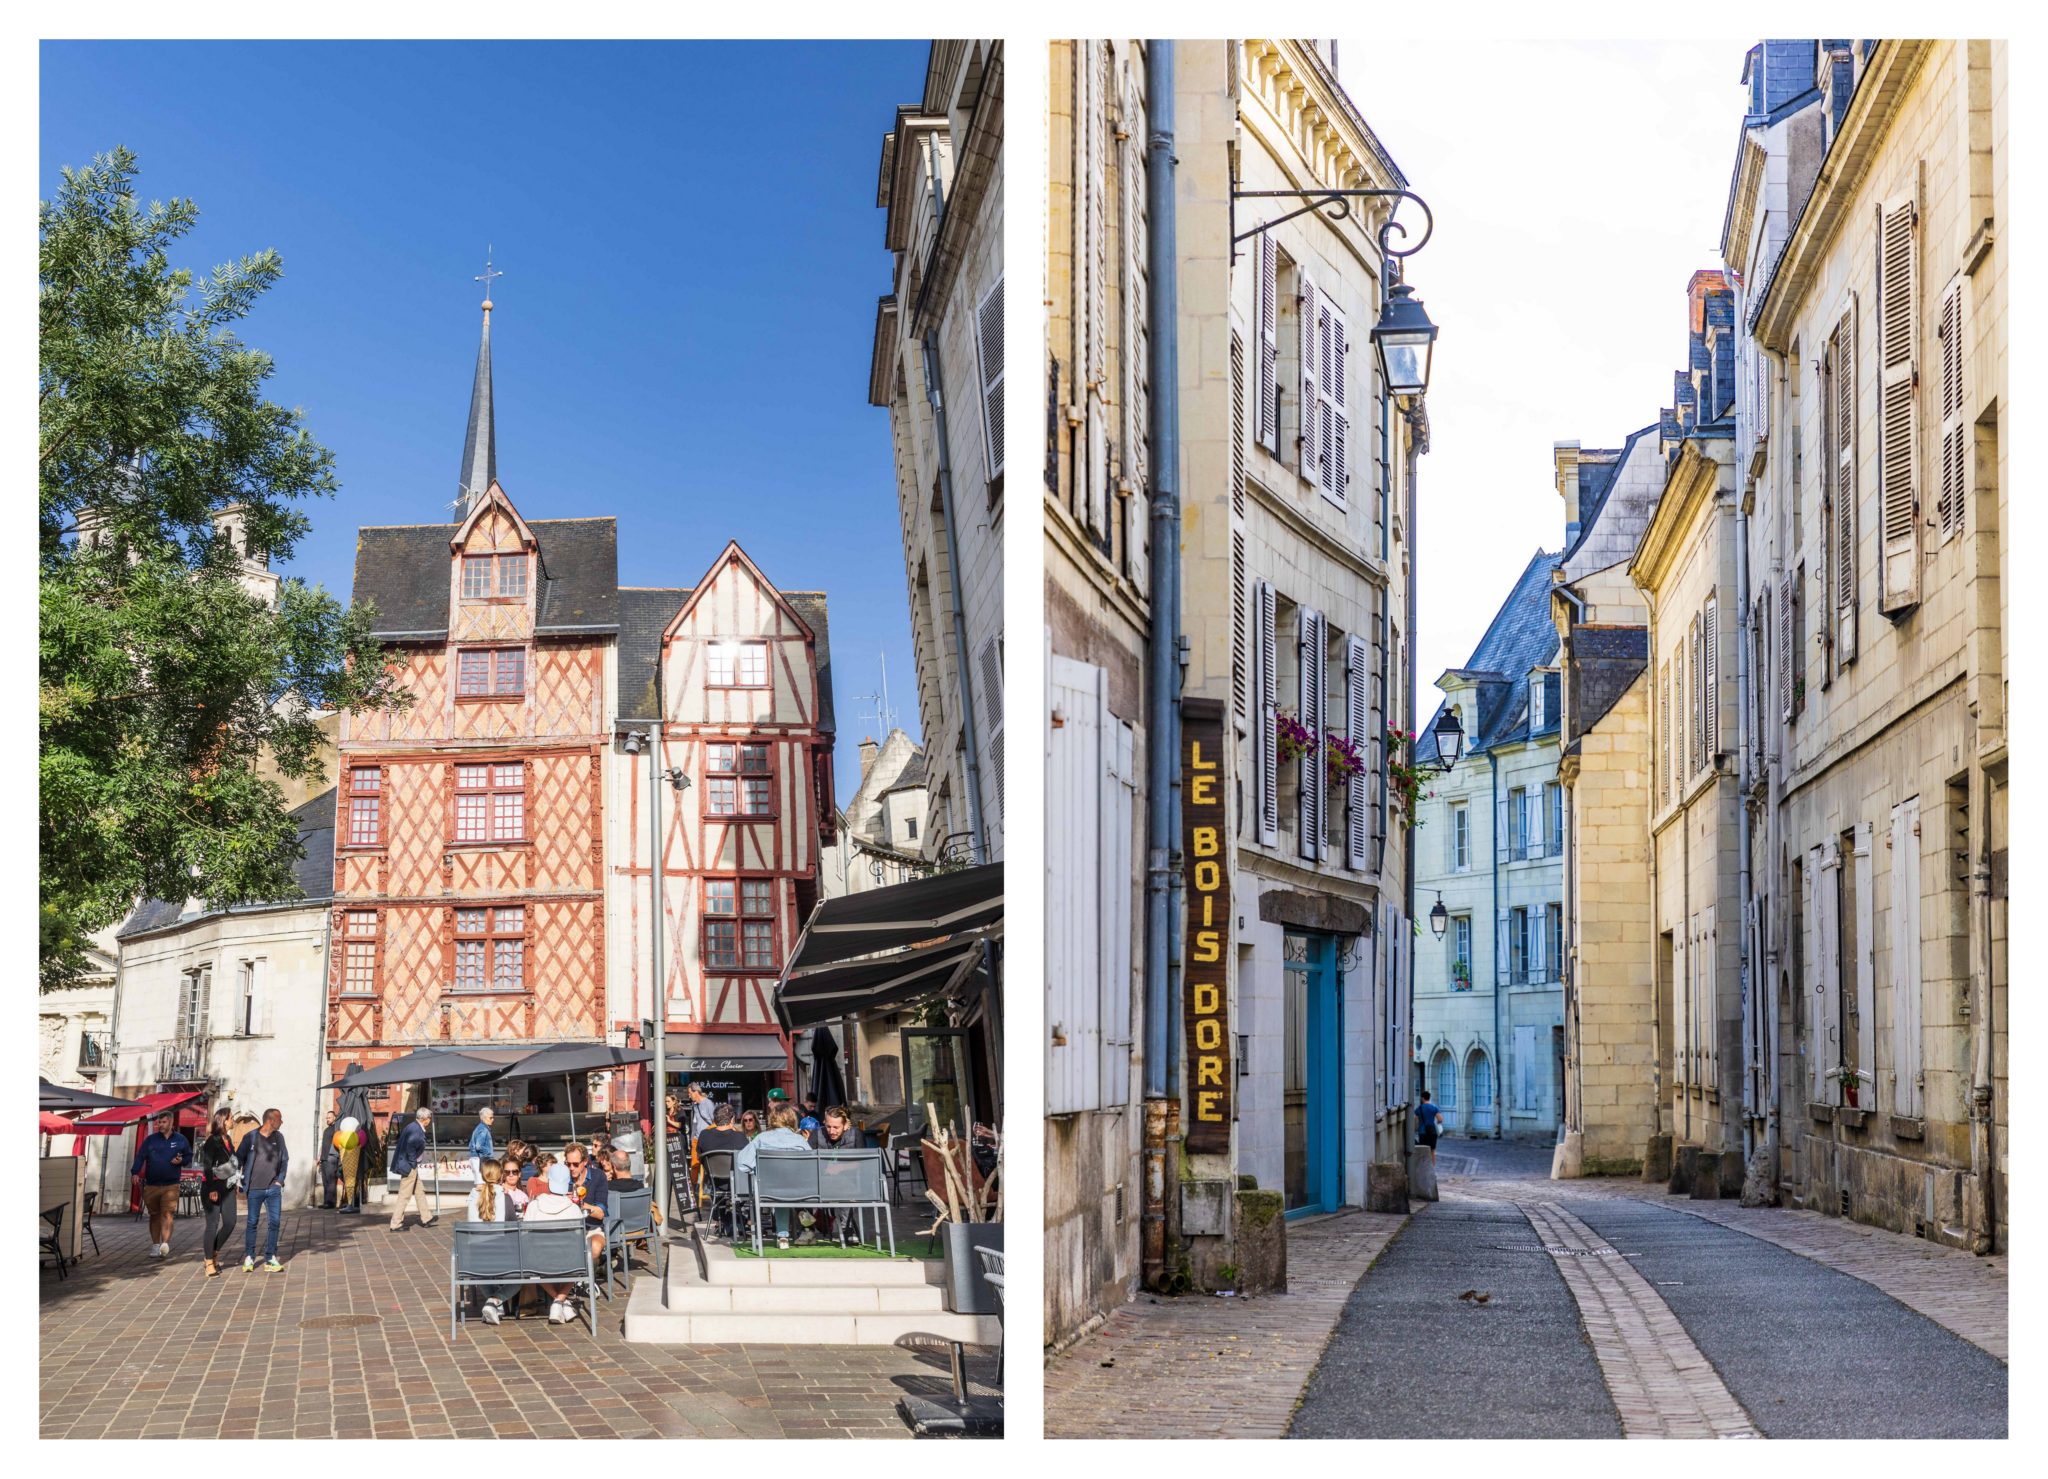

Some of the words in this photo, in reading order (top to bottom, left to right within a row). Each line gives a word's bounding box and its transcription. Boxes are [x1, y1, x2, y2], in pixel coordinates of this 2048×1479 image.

[1191, 740, 1217, 805] LE
[1193, 826, 1221, 962] BOIS
[690, 1060, 707, 1071] Café
[720, 1060, 744, 1071] Glacier
[1194, 983, 1223, 1122] DORE
